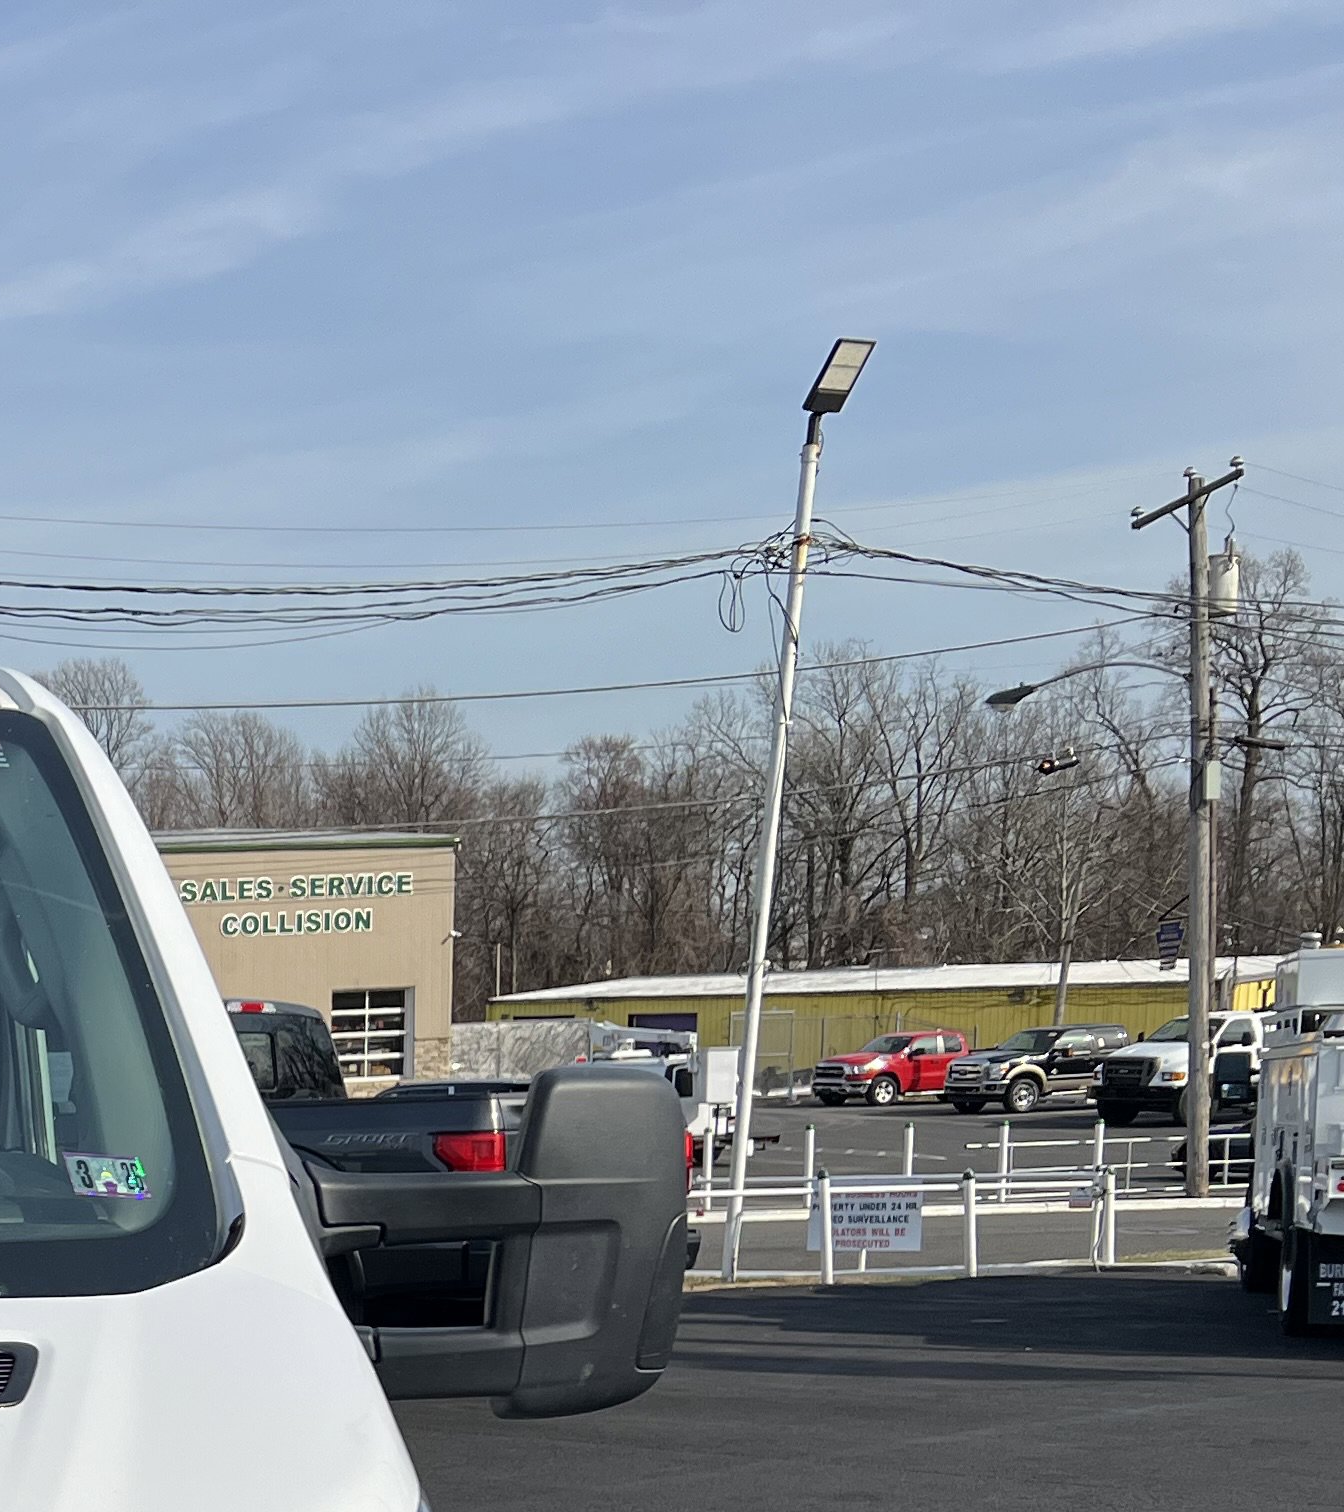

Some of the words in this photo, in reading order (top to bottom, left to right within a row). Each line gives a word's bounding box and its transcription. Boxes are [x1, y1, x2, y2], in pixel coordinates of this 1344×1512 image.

[179, 877, 274, 904] SALES
[289, 871, 414, 898] SERVICE
[220, 907, 373, 937] COLLISION
[320, 1132, 419, 1145] SPORT
[76, 1159, 93, 1189] 3
[812, 1203, 855, 1211] PERTY
[859, 1202, 887, 1211] UNDER
[891, 1202, 901, 1211] 24
[848, 1214, 910, 1224] SURVEILLANCE
[871, 1227, 890, 1237] WILL
[894, 1227, 906, 1237] BE
[835, 1239, 890, 1248] PROSECUTED
[1319, 1262, 1344, 1278] BUR
